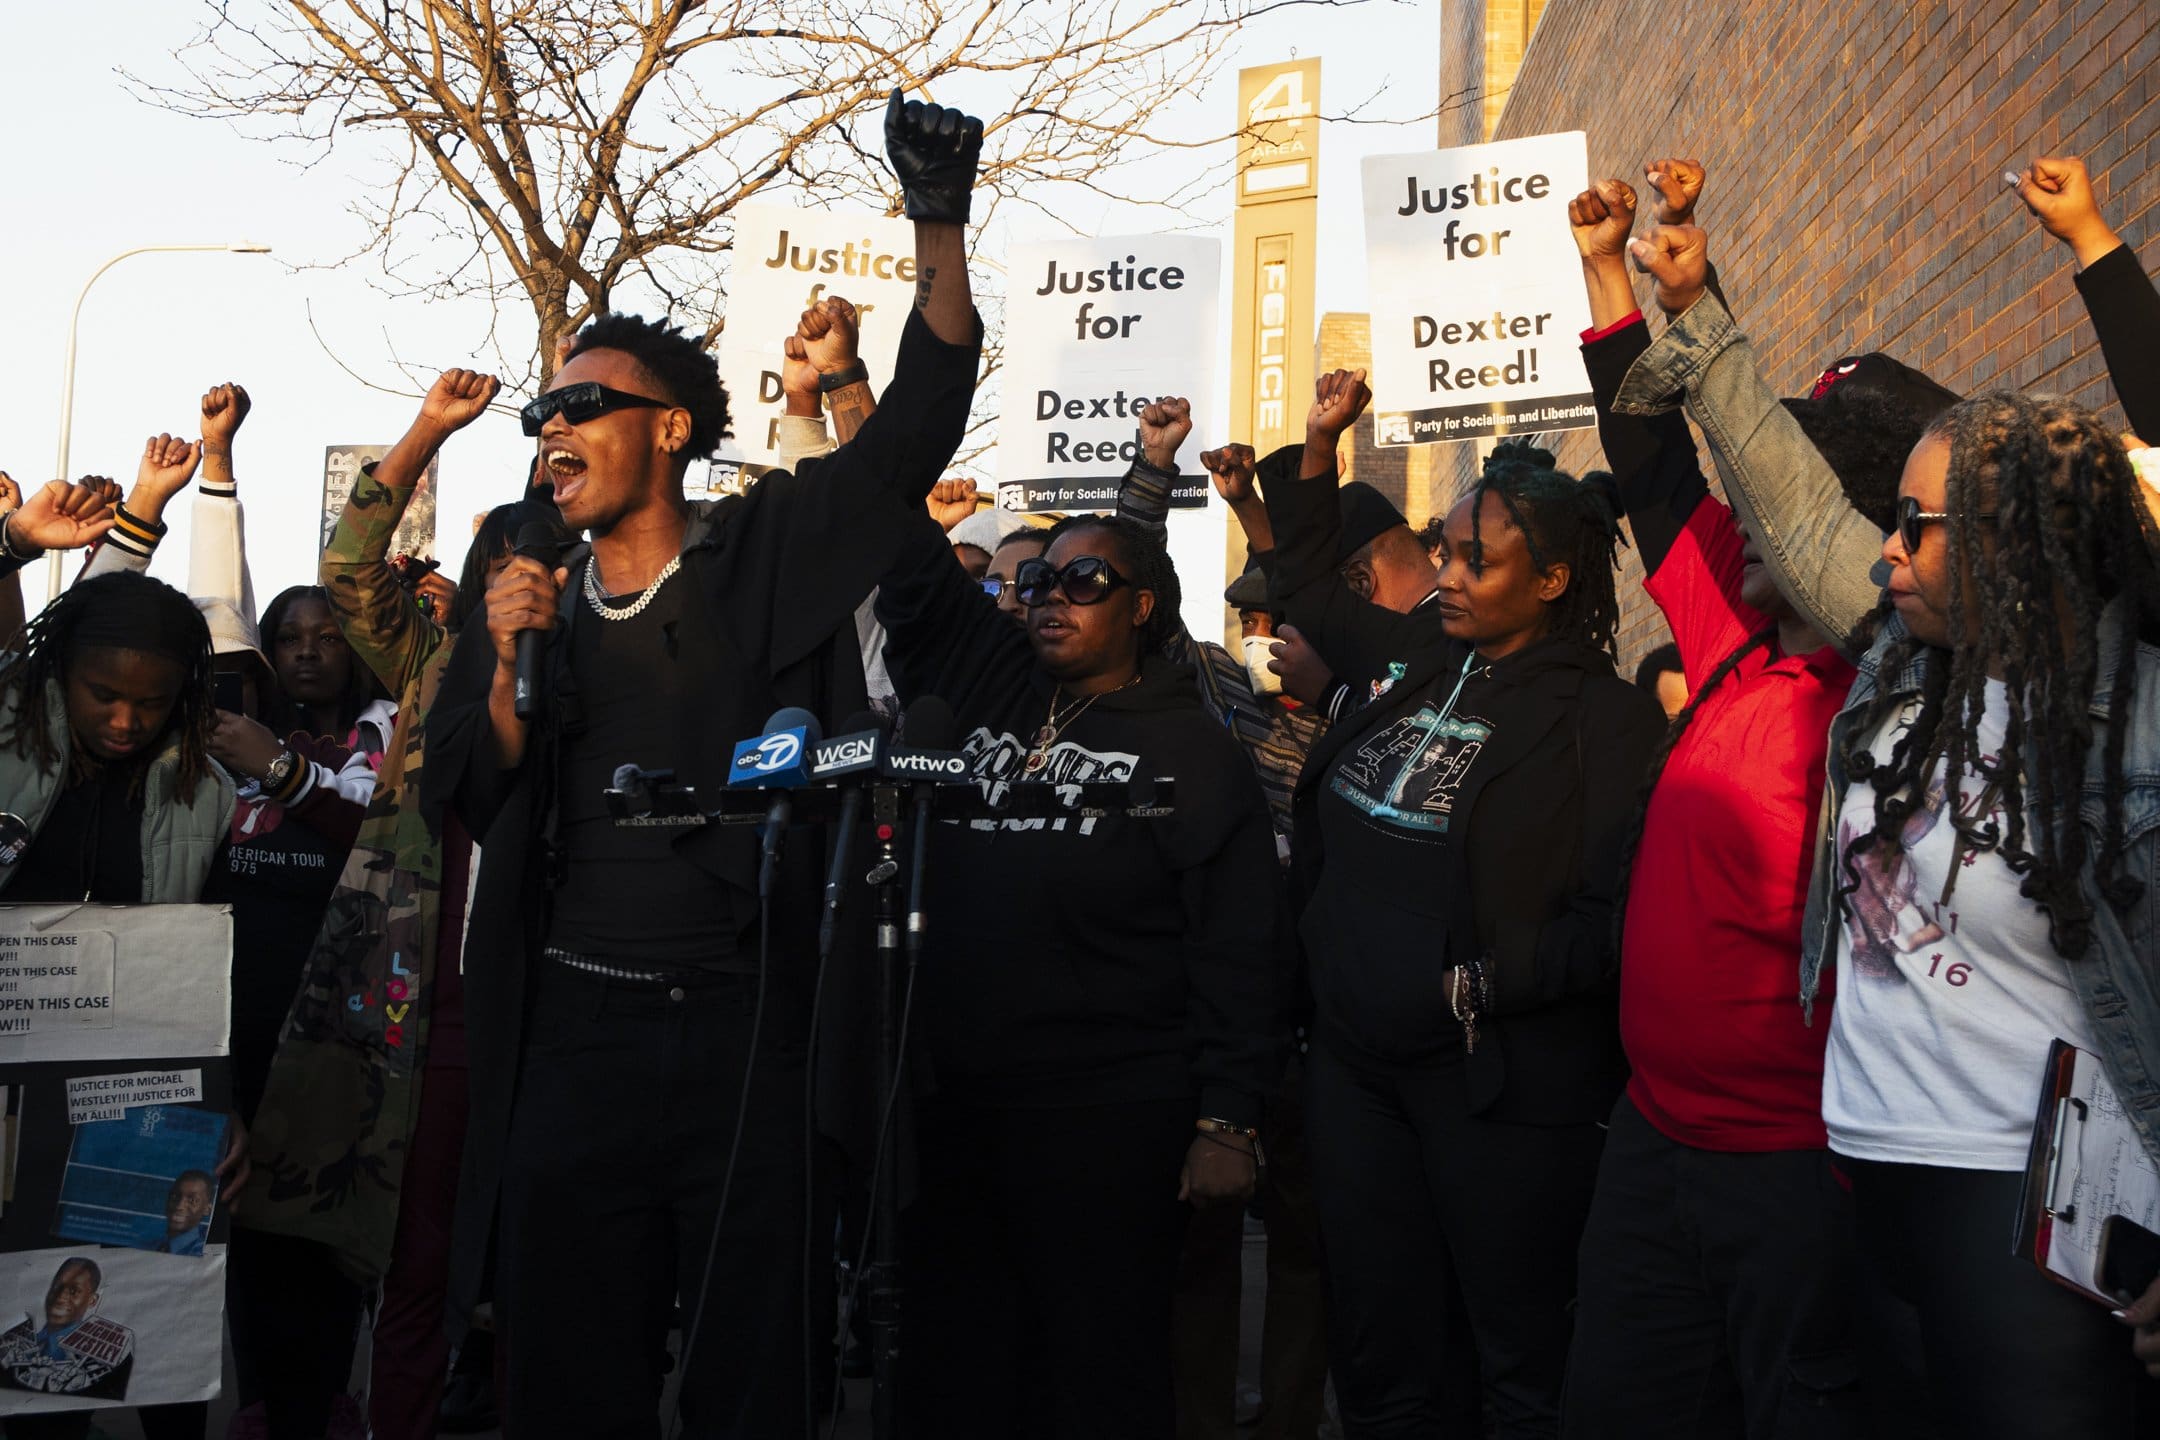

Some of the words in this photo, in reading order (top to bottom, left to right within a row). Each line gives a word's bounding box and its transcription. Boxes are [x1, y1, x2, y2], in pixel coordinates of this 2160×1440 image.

[1249, 70, 1312, 127] 4
[1251, 140, 1305, 159] AREA
[1397, 166, 1550, 216] Justice
[765, 230, 917, 283] Justice
[1443, 220, 1511, 261] for
[1036, 254, 1184, 296] Justice
[806, 283, 875, 329] fr
[1075, 302, 1142, 340] for
[1413, 311, 1552, 348] Dexter
[1260, 263, 1286, 430] POLICE
[1429, 348, 1539, 392] Reed!
[1036, 390, 1165, 421] Dexte
[1414, 420, 1442, 434] Party
[1445, 417, 1460, 429] for
[1463, 411, 1517, 429] Socialism
[1519, 409, 1539, 423] and
[1541, 404, 1596, 421] Liberation
[1029, 489, 1056, 503] Party
[1058, 488, 1074, 500] for
[1077, 486, 1119, 500] Socialis
[737, 753, 763, 766] abc
[756, 733, 799, 770] 7
[816, 736, 876, 765] WGN
[290, 852, 326, 868] TOUR
[24, 937, 48, 946] THIS
[51, 936, 78, 945] CASE
[23, 967, 48, 976] THIS
[50, 966, 78, 976] CASE
[1926, 952, 1974, 988] 16
[38, 997, 71, 1010] THIS
[74, 996, 110, 1009] CASE
[69, 1080, 110, 1092] JUSTICE
[113, 1078, 134, 1089] FOR
[137, 1074, 184, 1086] MICHAEL
[70, 1093, 130, 1107] WESTLEY!!!
[132, 1090, 172, 1102] JUSTICE
[175, 1087, 196, 1098] FOR
[71, 1113, 88, 1123] EM
[90, 1108, 121, 1120] ALL!!!
